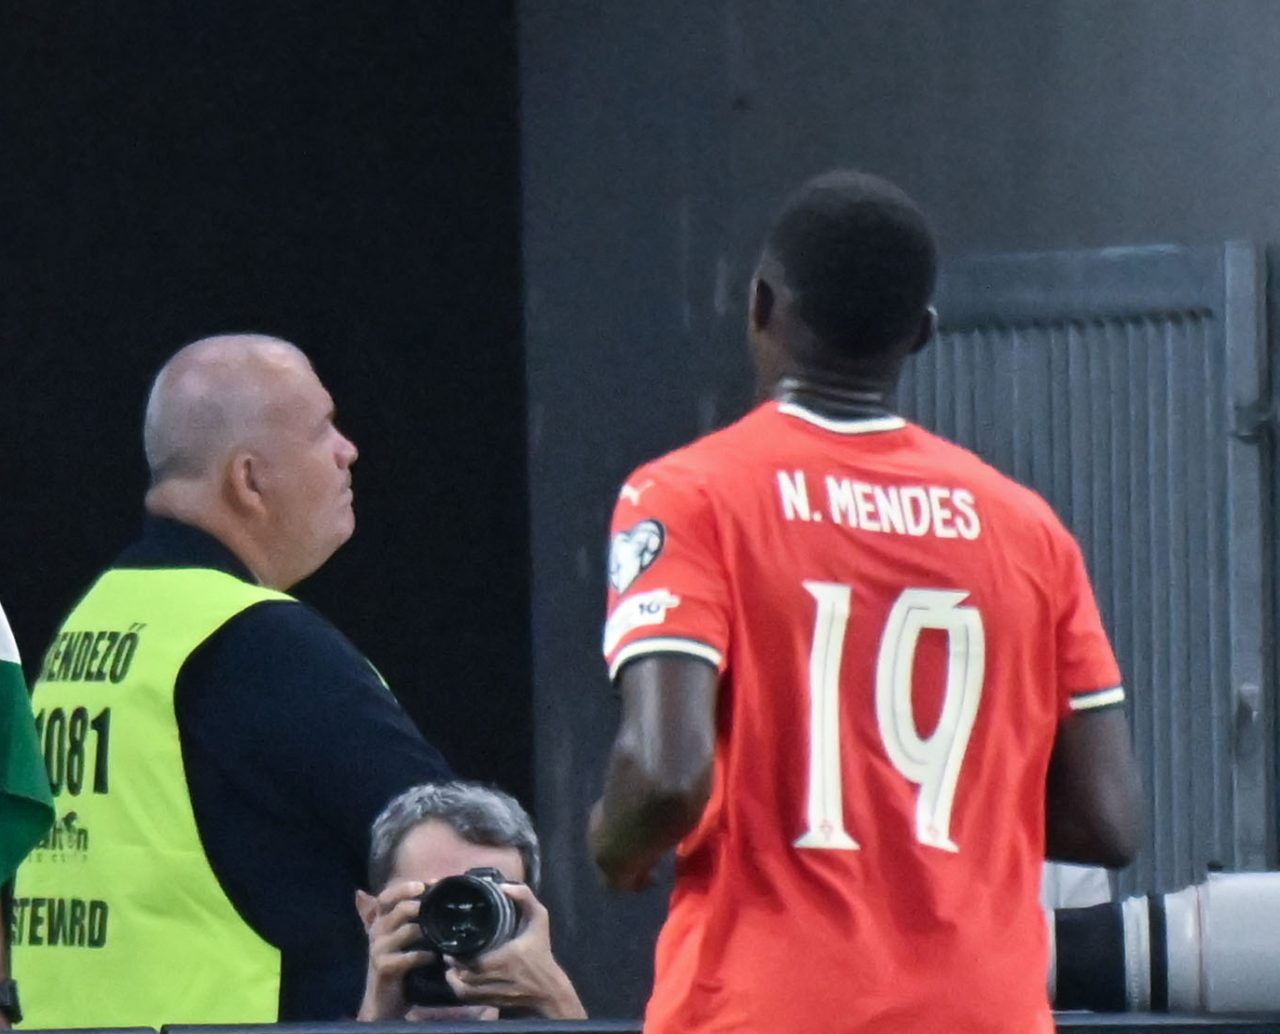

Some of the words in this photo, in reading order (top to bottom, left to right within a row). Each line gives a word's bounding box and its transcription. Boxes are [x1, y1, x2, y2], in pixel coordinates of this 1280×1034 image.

[776, 469, 822, 522] N.
[825, 475, 981, 540] MENDES
[792, 580, 986, 852] 19
